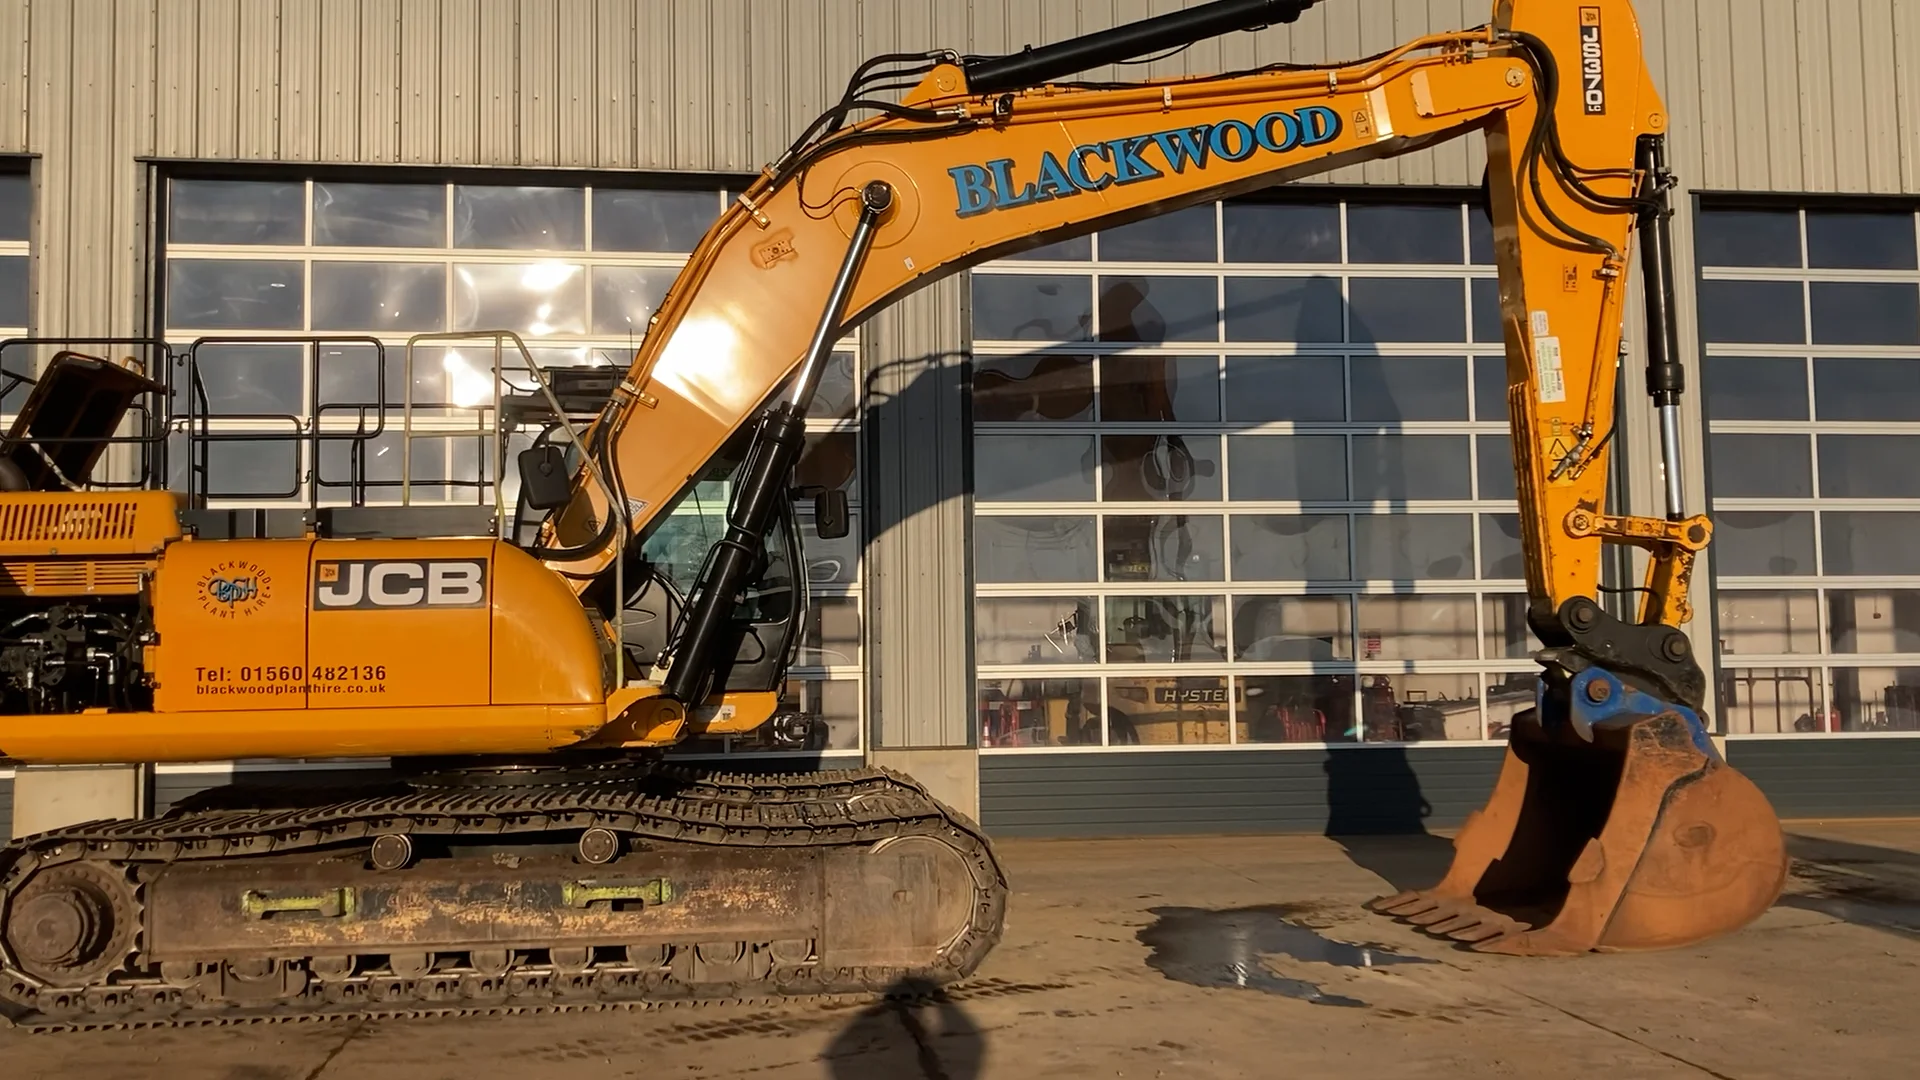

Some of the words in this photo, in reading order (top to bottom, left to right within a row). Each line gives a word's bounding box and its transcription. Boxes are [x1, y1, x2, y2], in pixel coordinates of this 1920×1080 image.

[1583, 27, 1603, 105] JS370
[948, 106, 1343, 218] BLACKWOOD
[197, 560, 272, 588] BLACKWOOD
[319, 563, 483, 606] JCB
[197, 595, 236, 619] PLANT
[244, 592, 272, 616] HIRE
[195, 667, 232, 682] Tel:
[240, 666, 303, 682] 01560
[311, 665, 387, 681] 482136
[196, 683, 387, 696] blackwoodplanthire.co.uk
